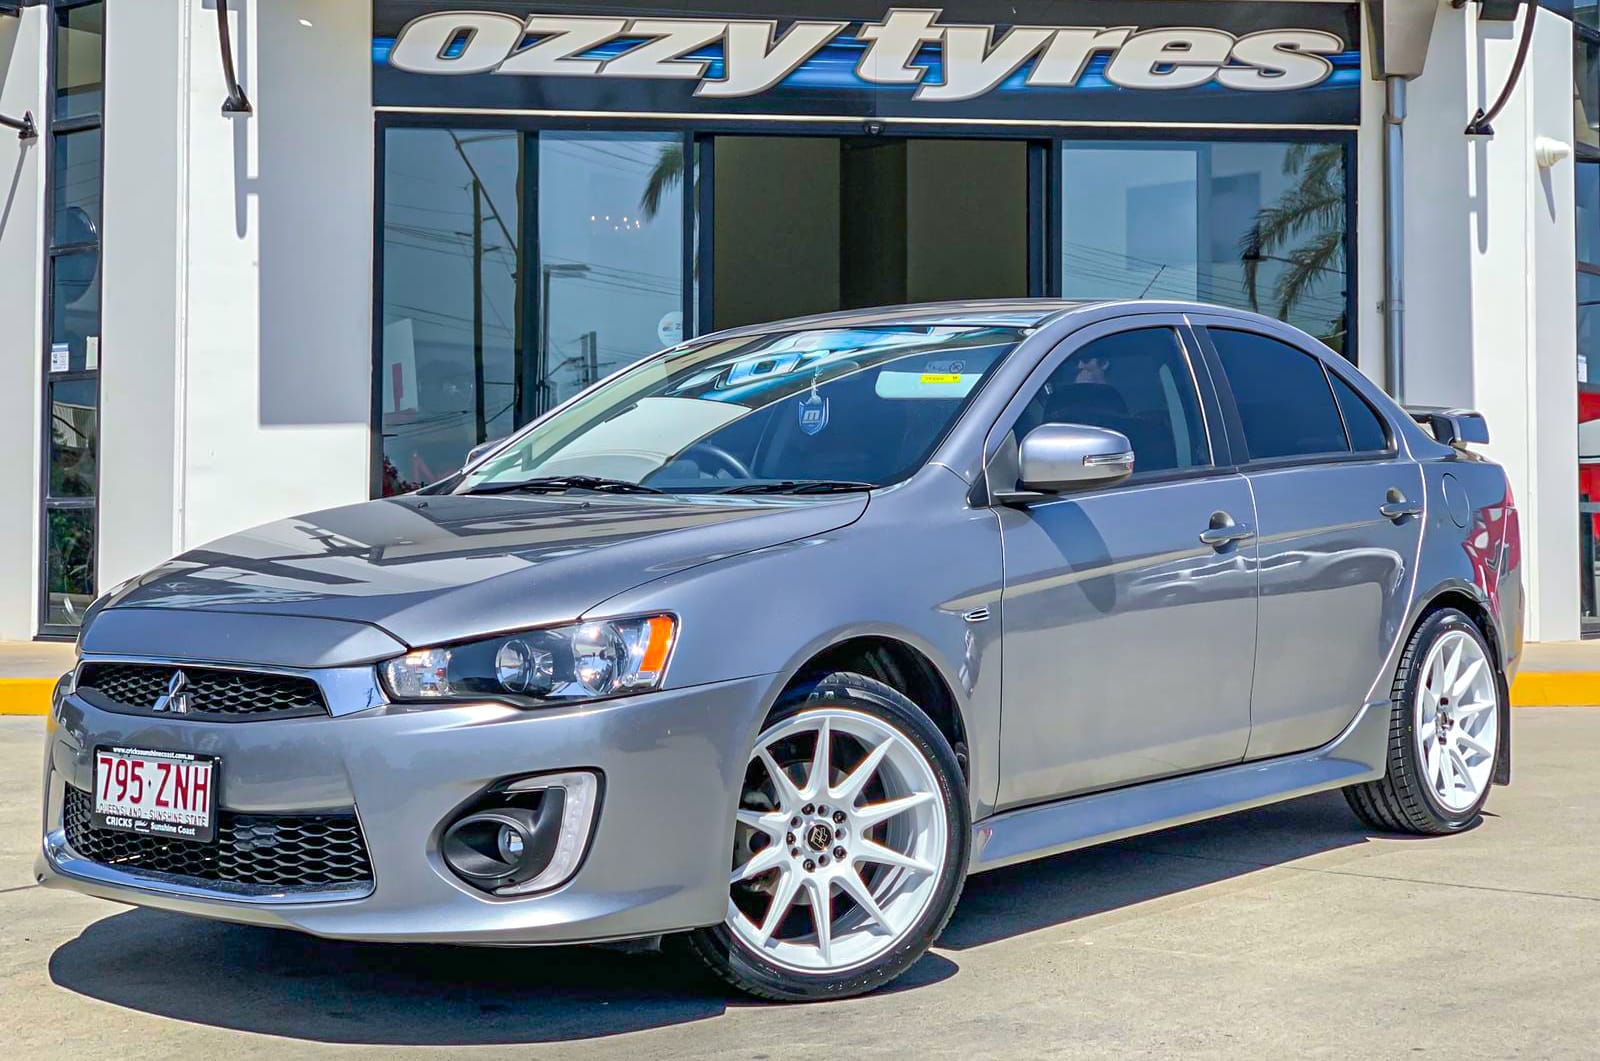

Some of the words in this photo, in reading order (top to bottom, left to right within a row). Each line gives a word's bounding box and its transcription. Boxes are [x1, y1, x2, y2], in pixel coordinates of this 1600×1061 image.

[389, 11, 850, 97] ozzy
[856, 7, 1344, 101] tyres
[106, 816, 132, 827] CRICKS
[150, 822, 177, 833] Sunshine
[178, 825, 195, 835] Coast
[185, 814, 207, 827] STATE
